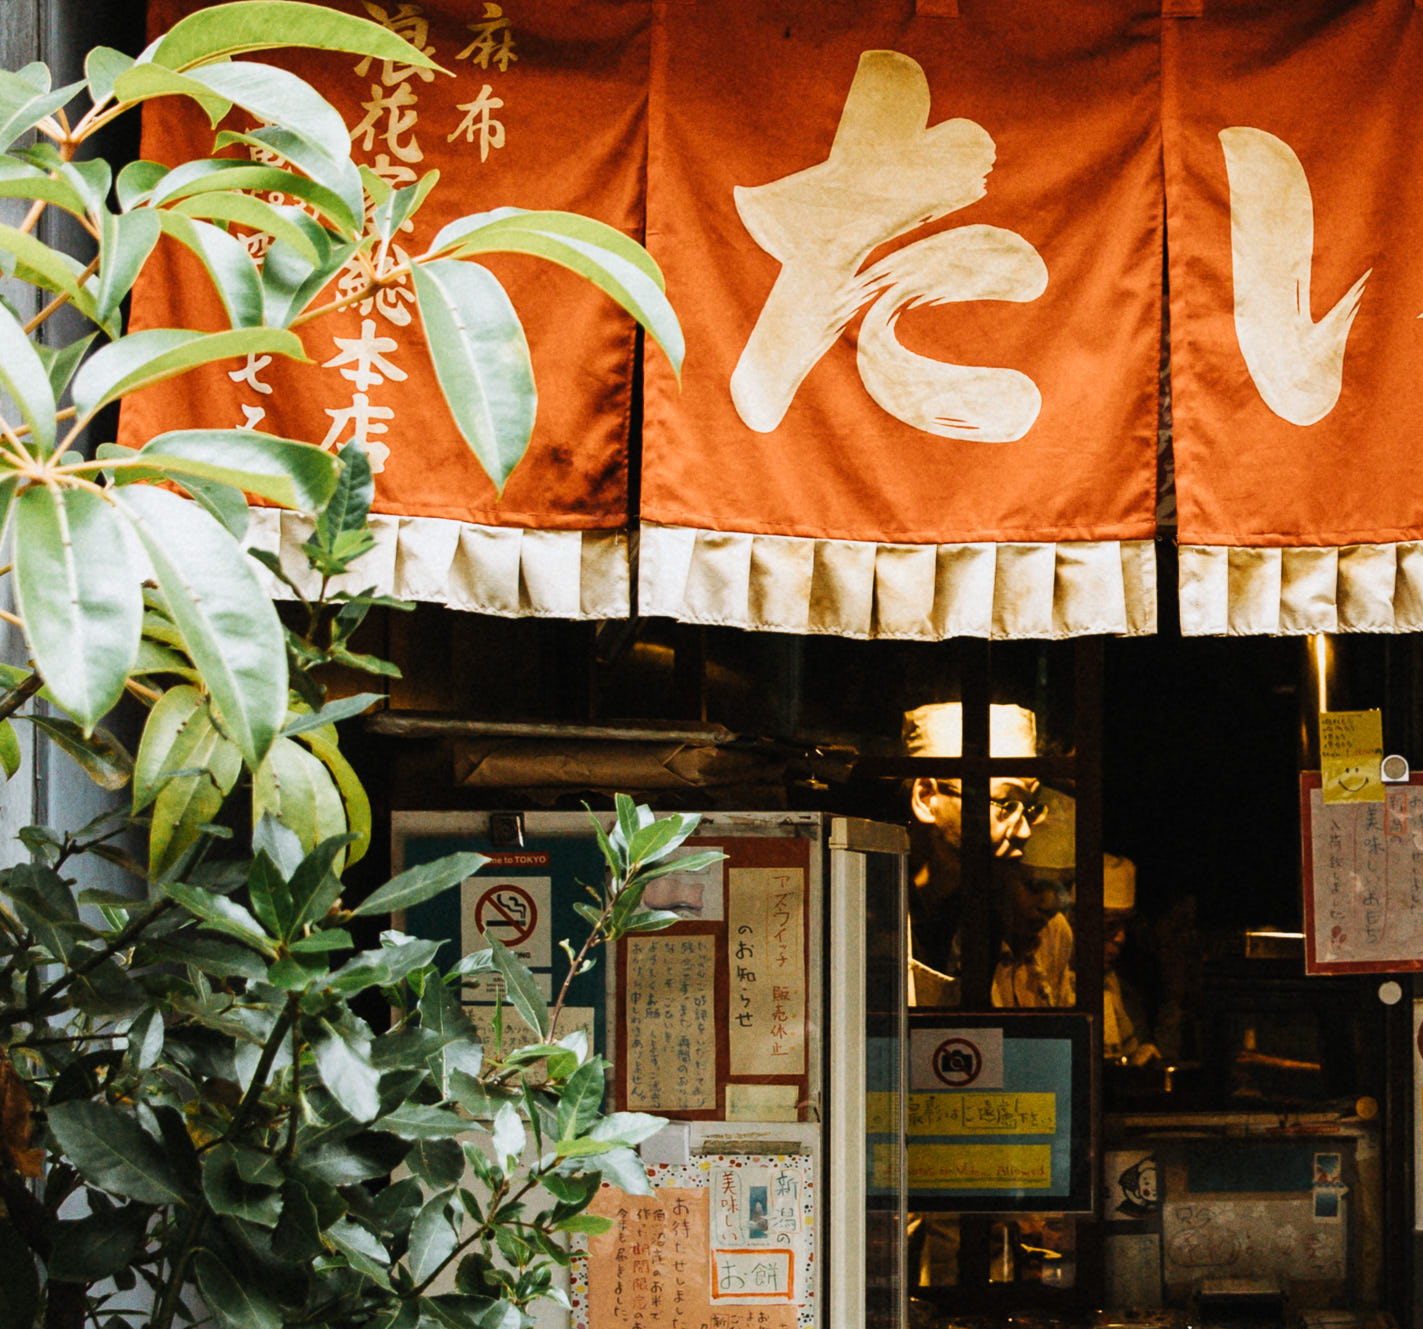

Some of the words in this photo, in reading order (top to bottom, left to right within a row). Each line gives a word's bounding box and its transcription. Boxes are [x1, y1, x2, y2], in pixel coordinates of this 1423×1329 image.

[446, 2, 519, 163] 麻布
[514, 855, 547, 864] TOKYO
[735, 924, 756, 1028] のお知らせ
[770, 985, 791, 1057] 販売休止
[721, 1171, 738, 1241] 美味しい
[720, 1260, 778, 1292] お餅
